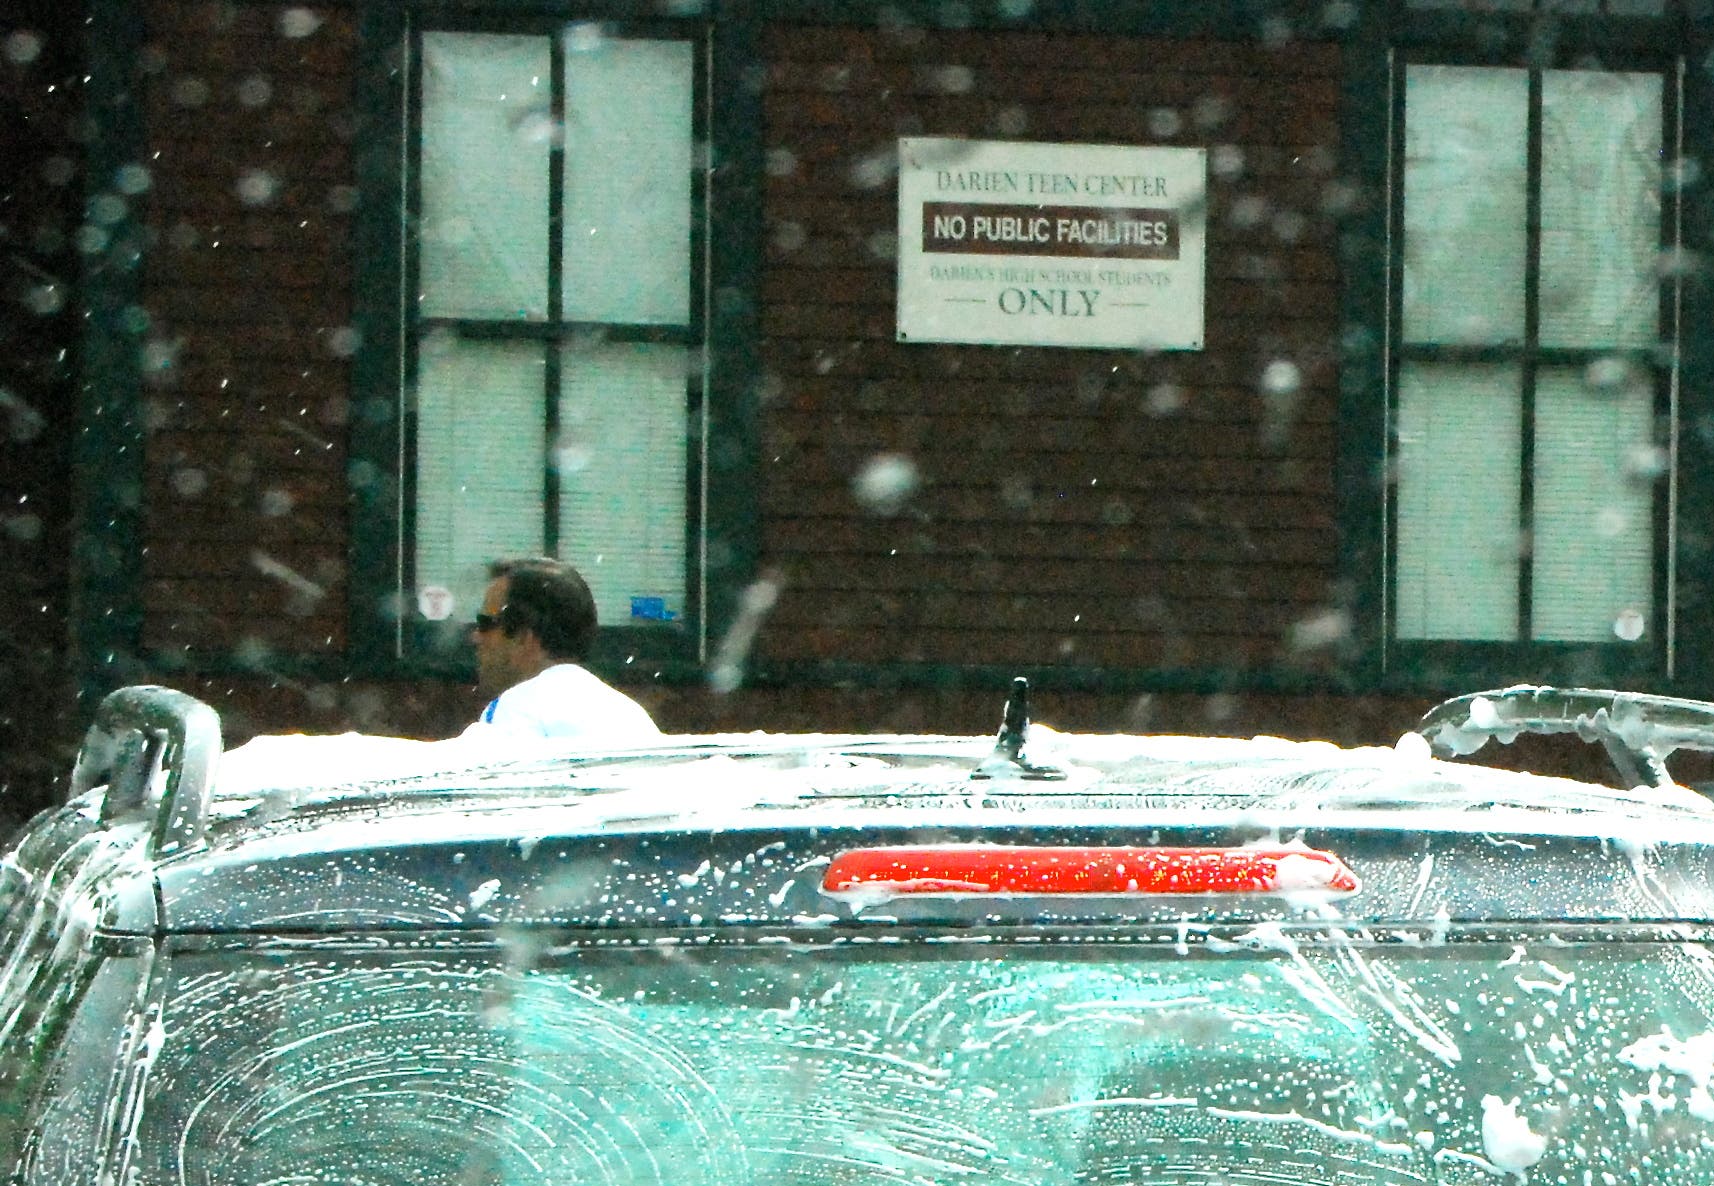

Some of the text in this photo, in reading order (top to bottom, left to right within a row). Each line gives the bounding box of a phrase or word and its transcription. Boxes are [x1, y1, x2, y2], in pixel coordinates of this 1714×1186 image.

[937, 171, 1168, 197] DARIEN TEEN CENTER
[933, 215, 1168, 245] NO PUBLIC FACILITIES
[998, 287, 1101, 317] ONLY
